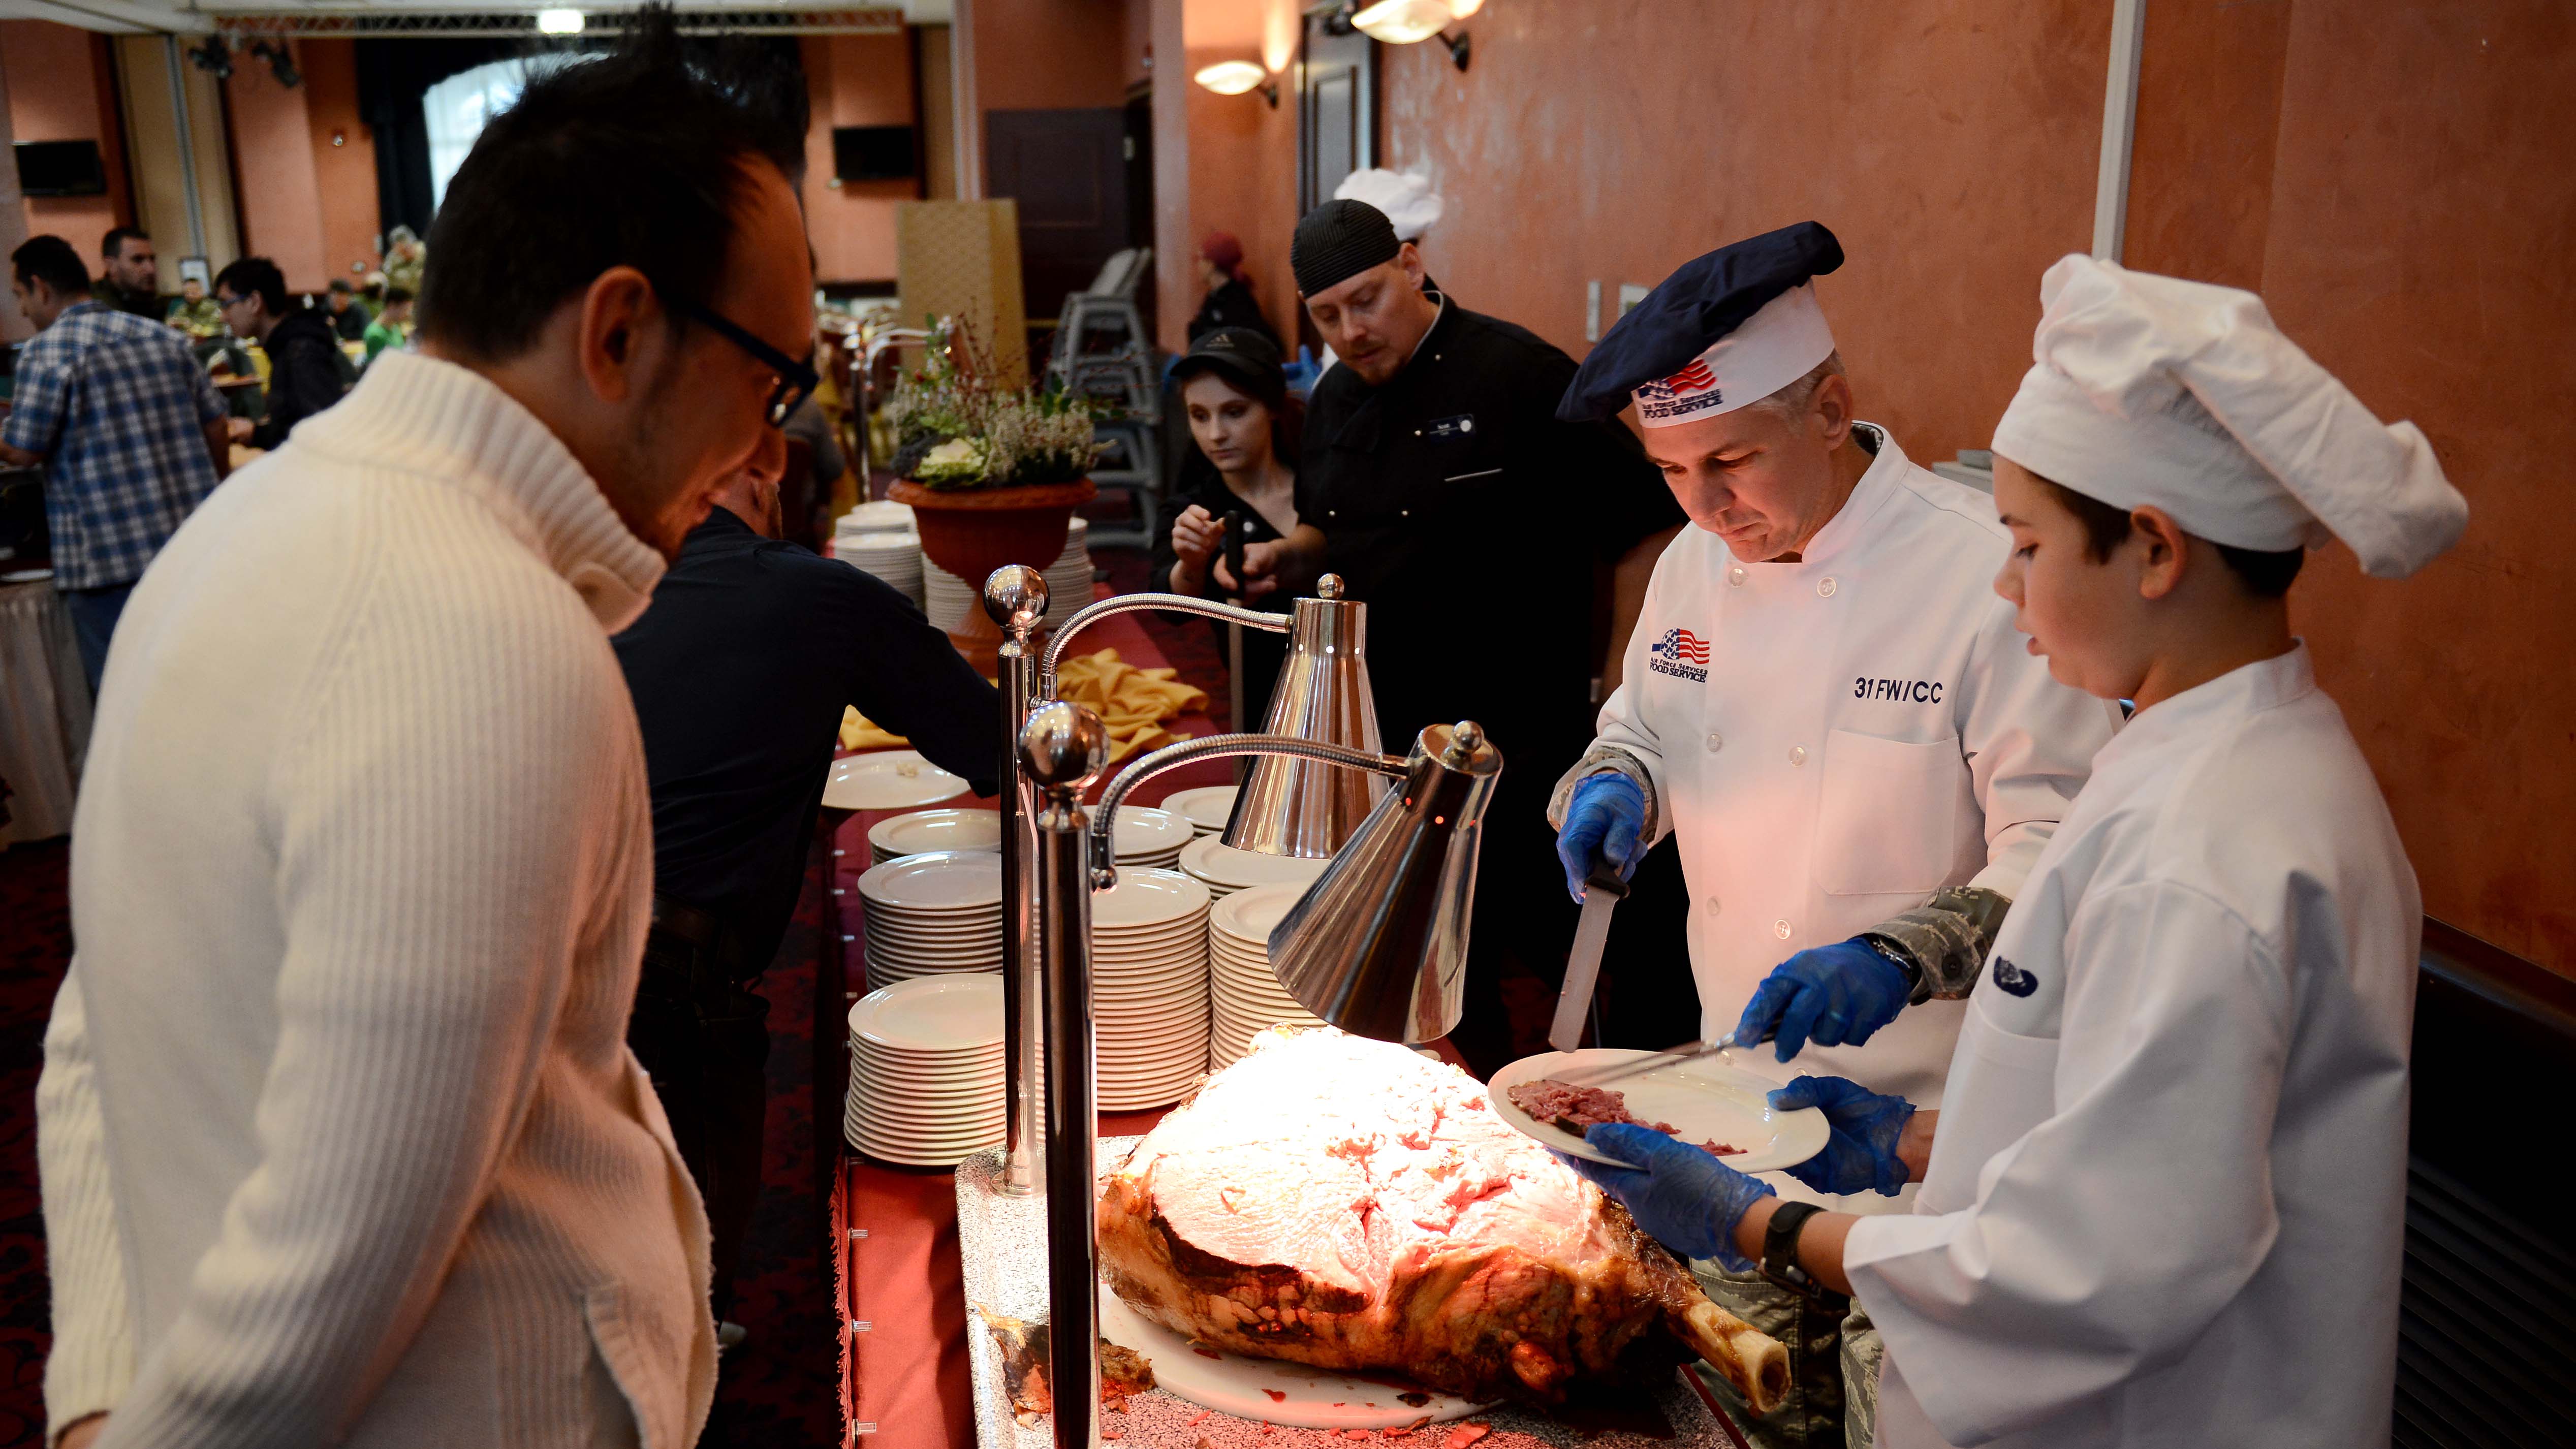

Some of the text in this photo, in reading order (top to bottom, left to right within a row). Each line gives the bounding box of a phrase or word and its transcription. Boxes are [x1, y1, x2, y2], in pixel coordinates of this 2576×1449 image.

[1650, 662, 1707, 683] FOOD SERVICE
[1659, 659, 1676, 668] FORCE
[1678, 664, 1708, 675] SERVICES
